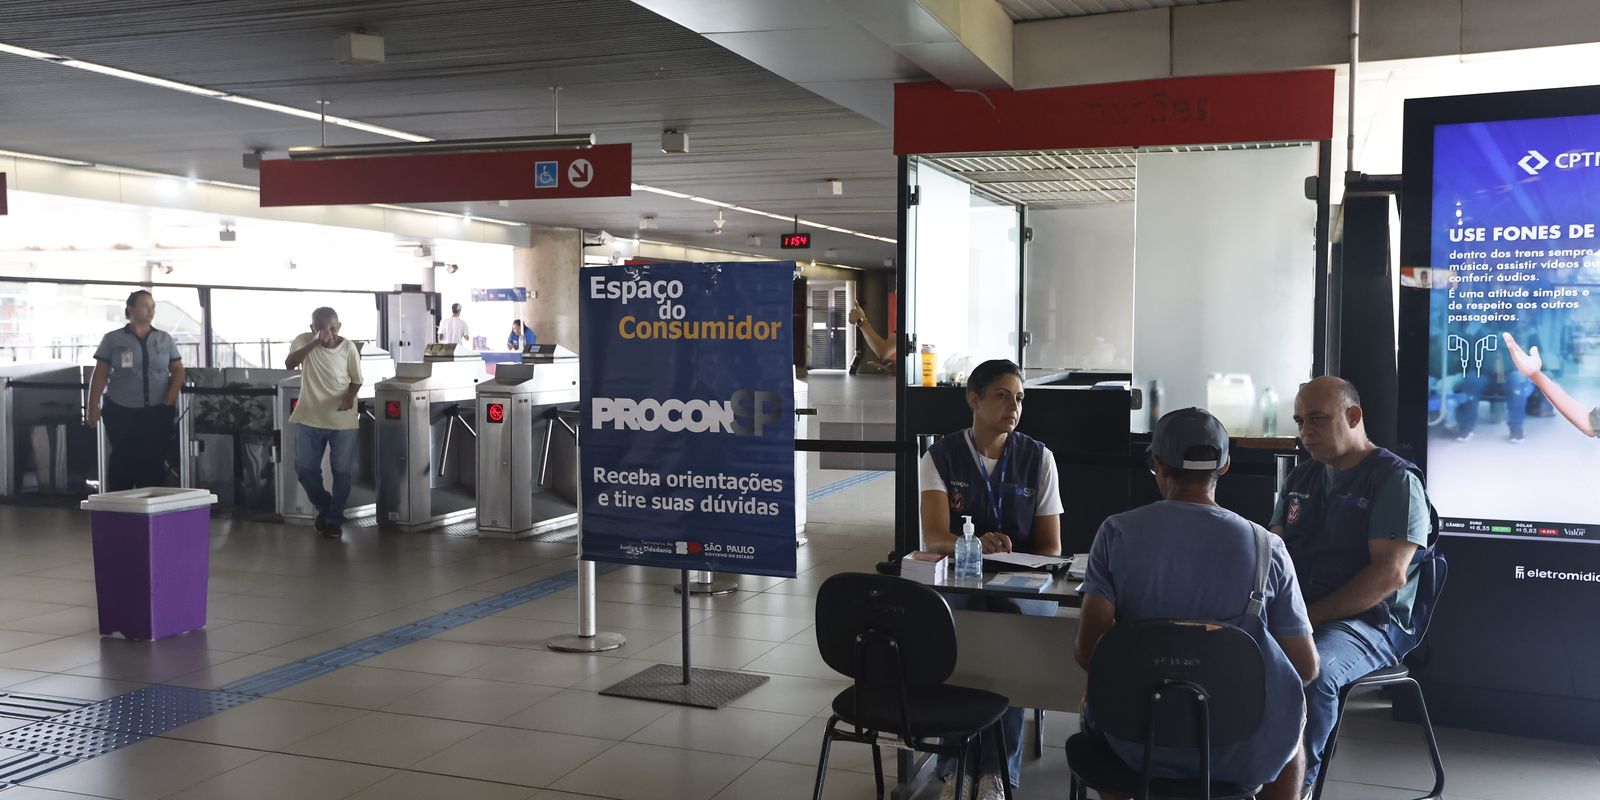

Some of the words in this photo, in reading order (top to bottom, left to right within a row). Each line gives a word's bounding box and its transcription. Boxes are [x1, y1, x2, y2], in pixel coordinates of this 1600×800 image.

[1449, 227, 1486, 242] USE
[1493, 225, 1561, 241] FONES
[1568, 223, 1595, 239] DE
[1449, 250, 1487, 260] dentro
[1490, 249, 1512, 259] dos
[1514, 249, 1545, 258] trens
[1548, 248, 1593, 258] sempre
[1449, 263, 1493, 272] música,
[1496, 260, 1537, 270] assistir
[1540, 258, 1580, 269] vídeos
[1448, 272, 1493, 283] conferir
[1496, 271, 1540, 282] áudios.
[590, 276, 684, 304] Espaço
[1448, 288, 1455, 299] É
[1487, 288, 1529, 298] atitude
[1532, 287, 1578, 299] simples
[1582, 289, 1590, 297] e
[658, 300, 686, 320] do
[1448, 300, 1463, 310] de
[1466, 301, 1513, 311] respeito
[1516, 301, 1537, 309] aos
[1541, 300, 1579, 309] outros
[1448, 313, 1520, 323] passageiros.
[618, 315, 782, 341] Consumidor
[593, 466, 661, 487] Receba
[666, 470, 783, 495] orientações
[598, 493, 609, 507] e
[614, 490, 647, 509] tire
[651, 496, 695, 512] suas
[700, 493, 780, 516] dúvidas
[703, 541, 723, 552] SÃO
[726, 545, 755, 555] PAULO
